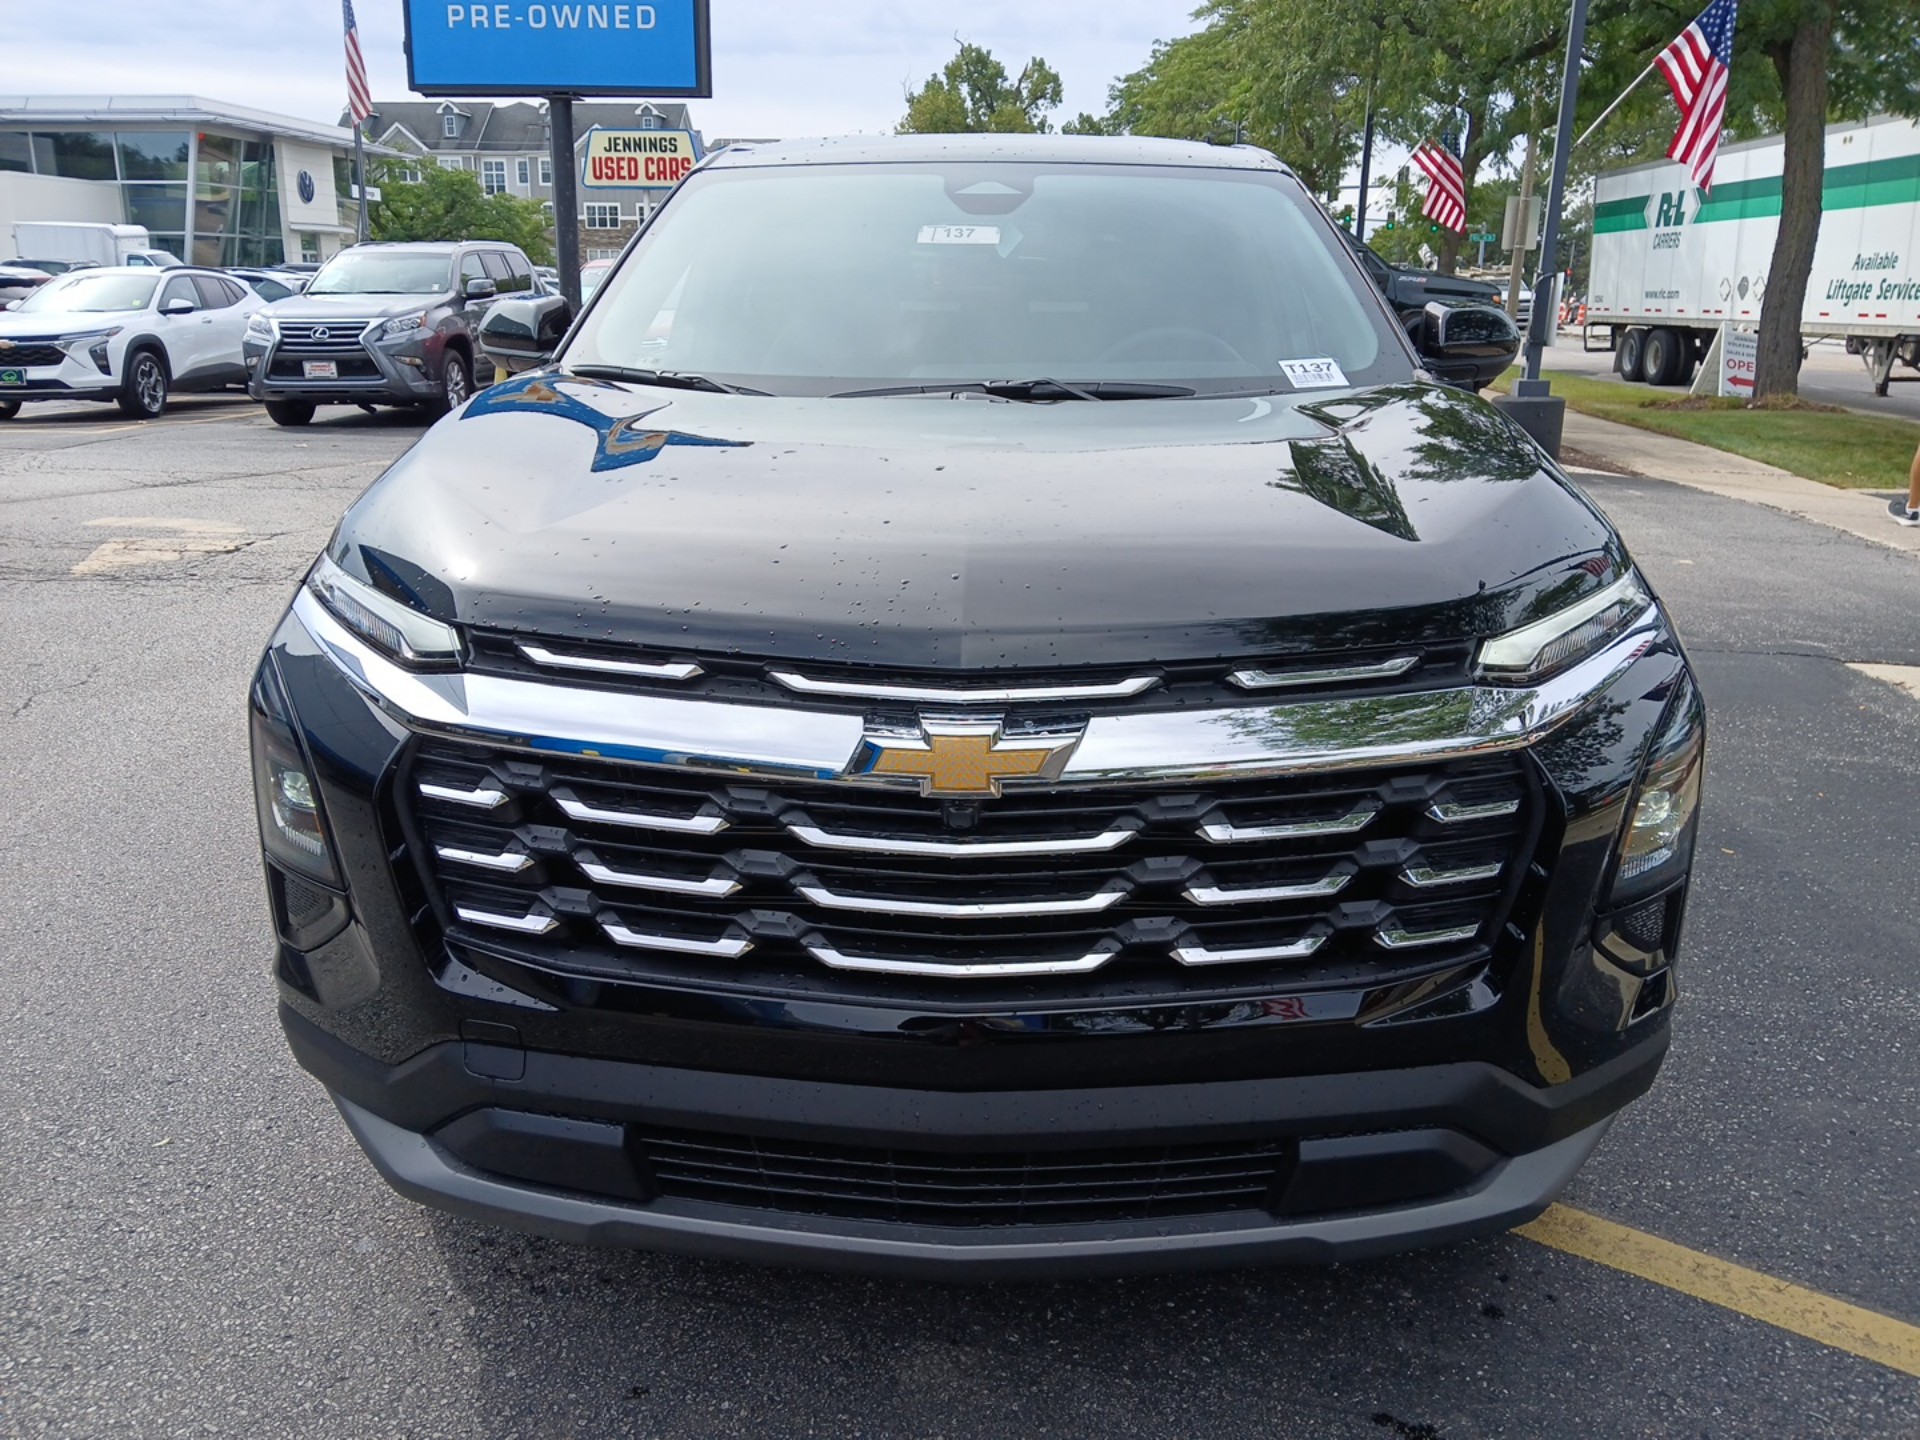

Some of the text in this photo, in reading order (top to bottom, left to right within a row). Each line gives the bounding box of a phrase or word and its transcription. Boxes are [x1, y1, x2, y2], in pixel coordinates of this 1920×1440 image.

[447, 4, 657, 29] PRE-OWNED
[603, 136, 678, 153] JENNINGS
[592, 156, 692, 181] USED CARS
[1851, 251, 1899, 271] Available
[1826, 278, 1920, 307] Liftgate Service
[1284, 362, 1332, 374] T137
[1727, 358, 1755, 372] OPE
